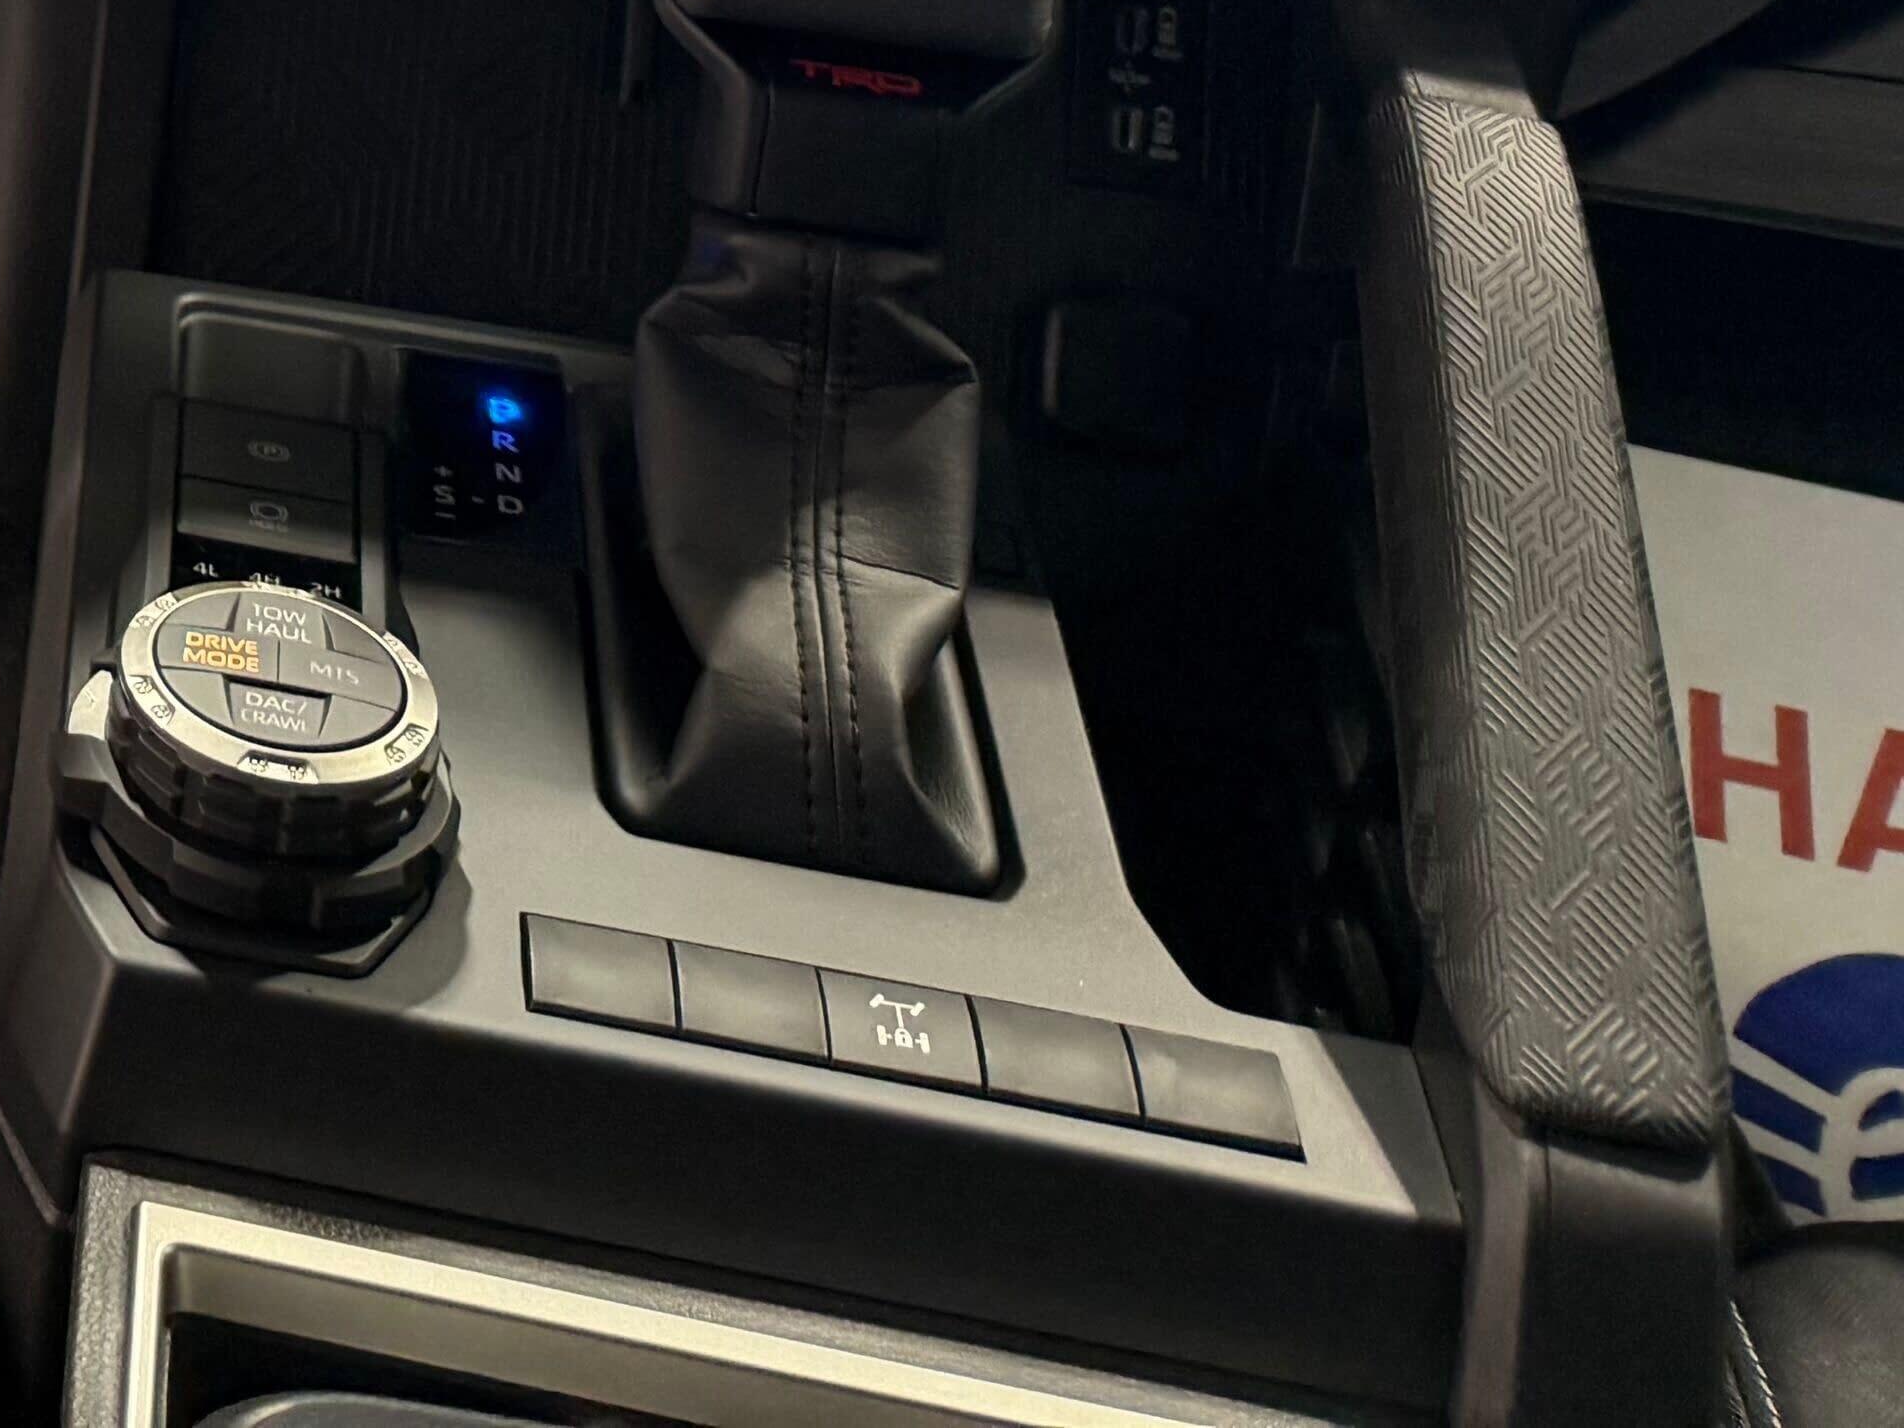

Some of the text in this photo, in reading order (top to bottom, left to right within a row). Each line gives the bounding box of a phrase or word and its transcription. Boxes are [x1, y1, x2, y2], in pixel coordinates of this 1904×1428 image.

[789, 58, 923, 96] TRD
[492, 429, 520, 453] R
[495, 462, 522, 484] N
[433, 483, 524, 515] S D
[193, 561, 219, 578] 4L
[309, 582, 342, 600] 2H
[252, 602, 306, 625] TOW
[185, 631, 258, 656] DRIVE
[246, 618, 312, 644] HAUL
[182, 647, 260, 673] MODE
[245, 691, 308, 715] DAC/
